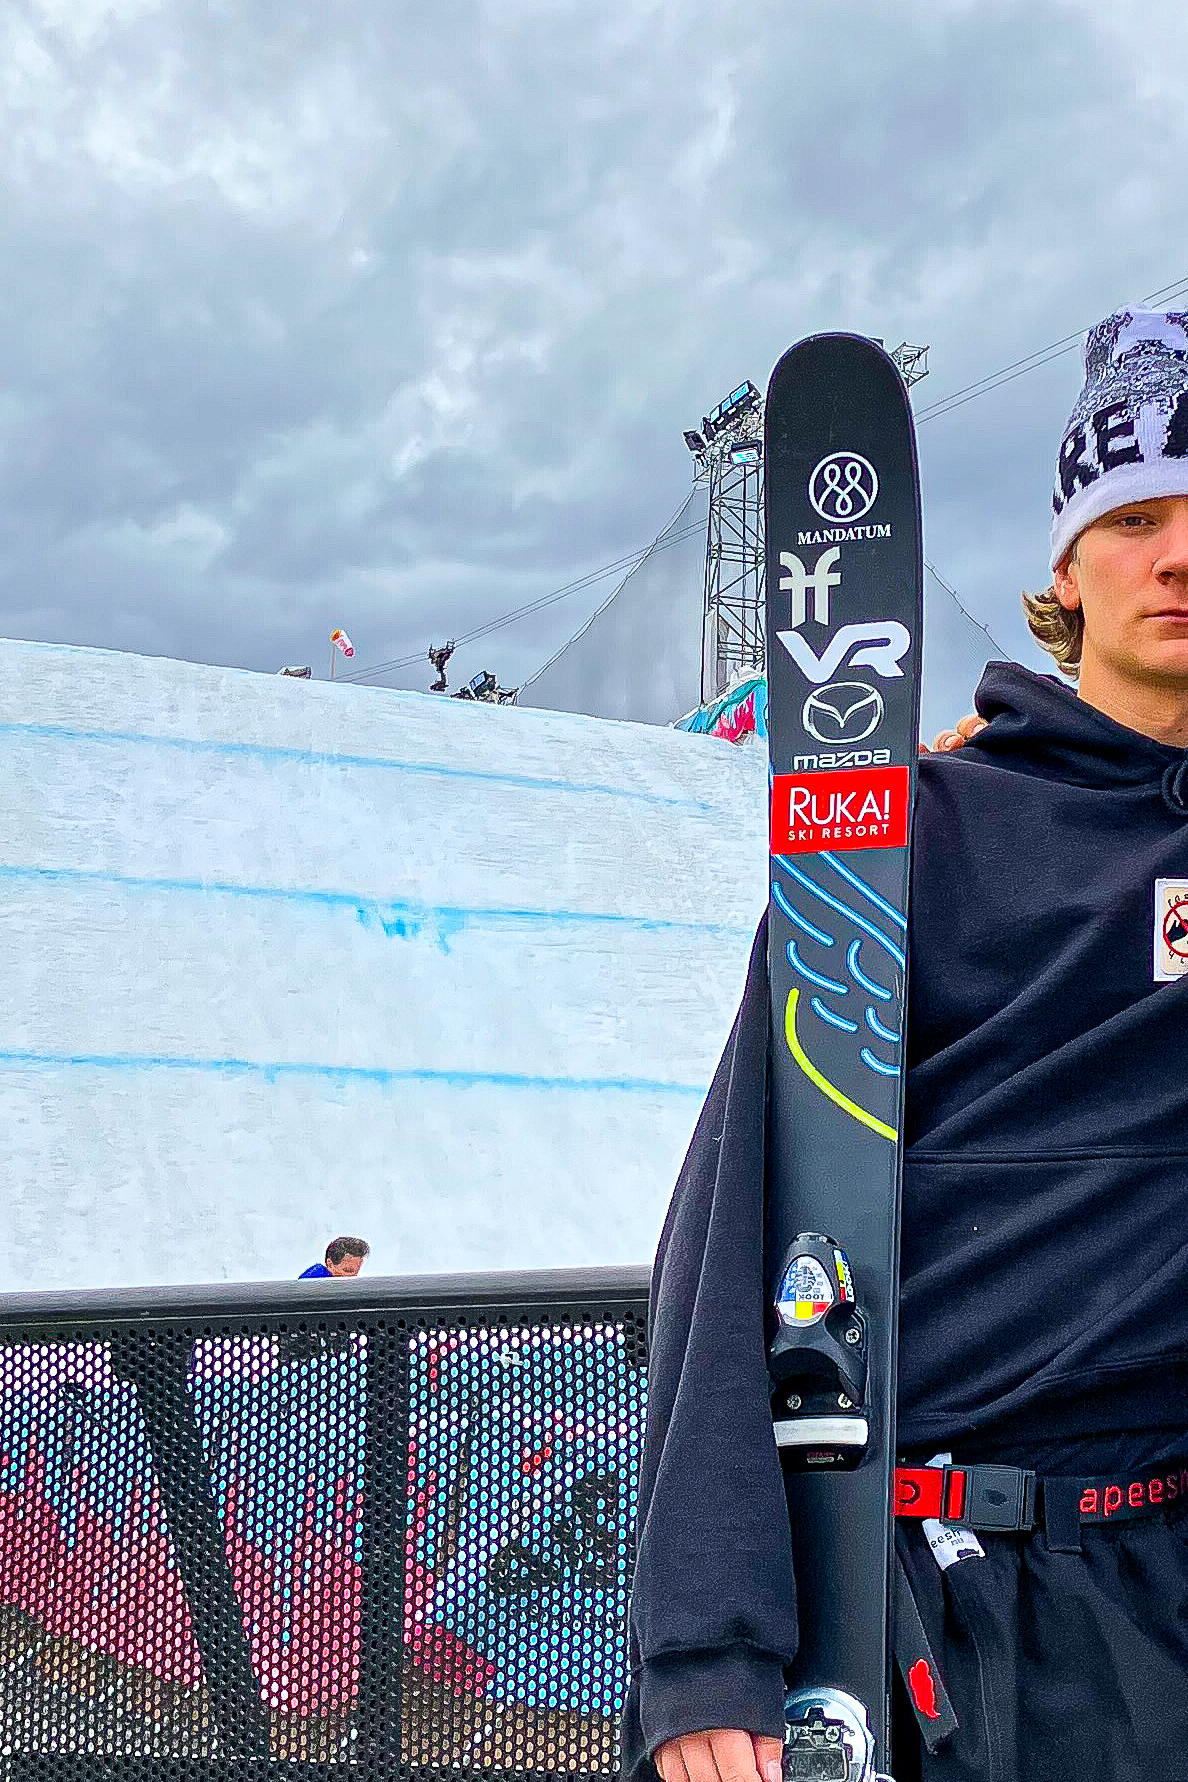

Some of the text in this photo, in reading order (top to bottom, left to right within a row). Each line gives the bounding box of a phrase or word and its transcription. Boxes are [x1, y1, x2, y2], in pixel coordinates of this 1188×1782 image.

[797, 523, 892, 545] MANDATUM
[775, 620, 911, 684] VR
[788, 786, 891, 827] RUKA!
[788, 823, 890, 841] SKI RESORT
